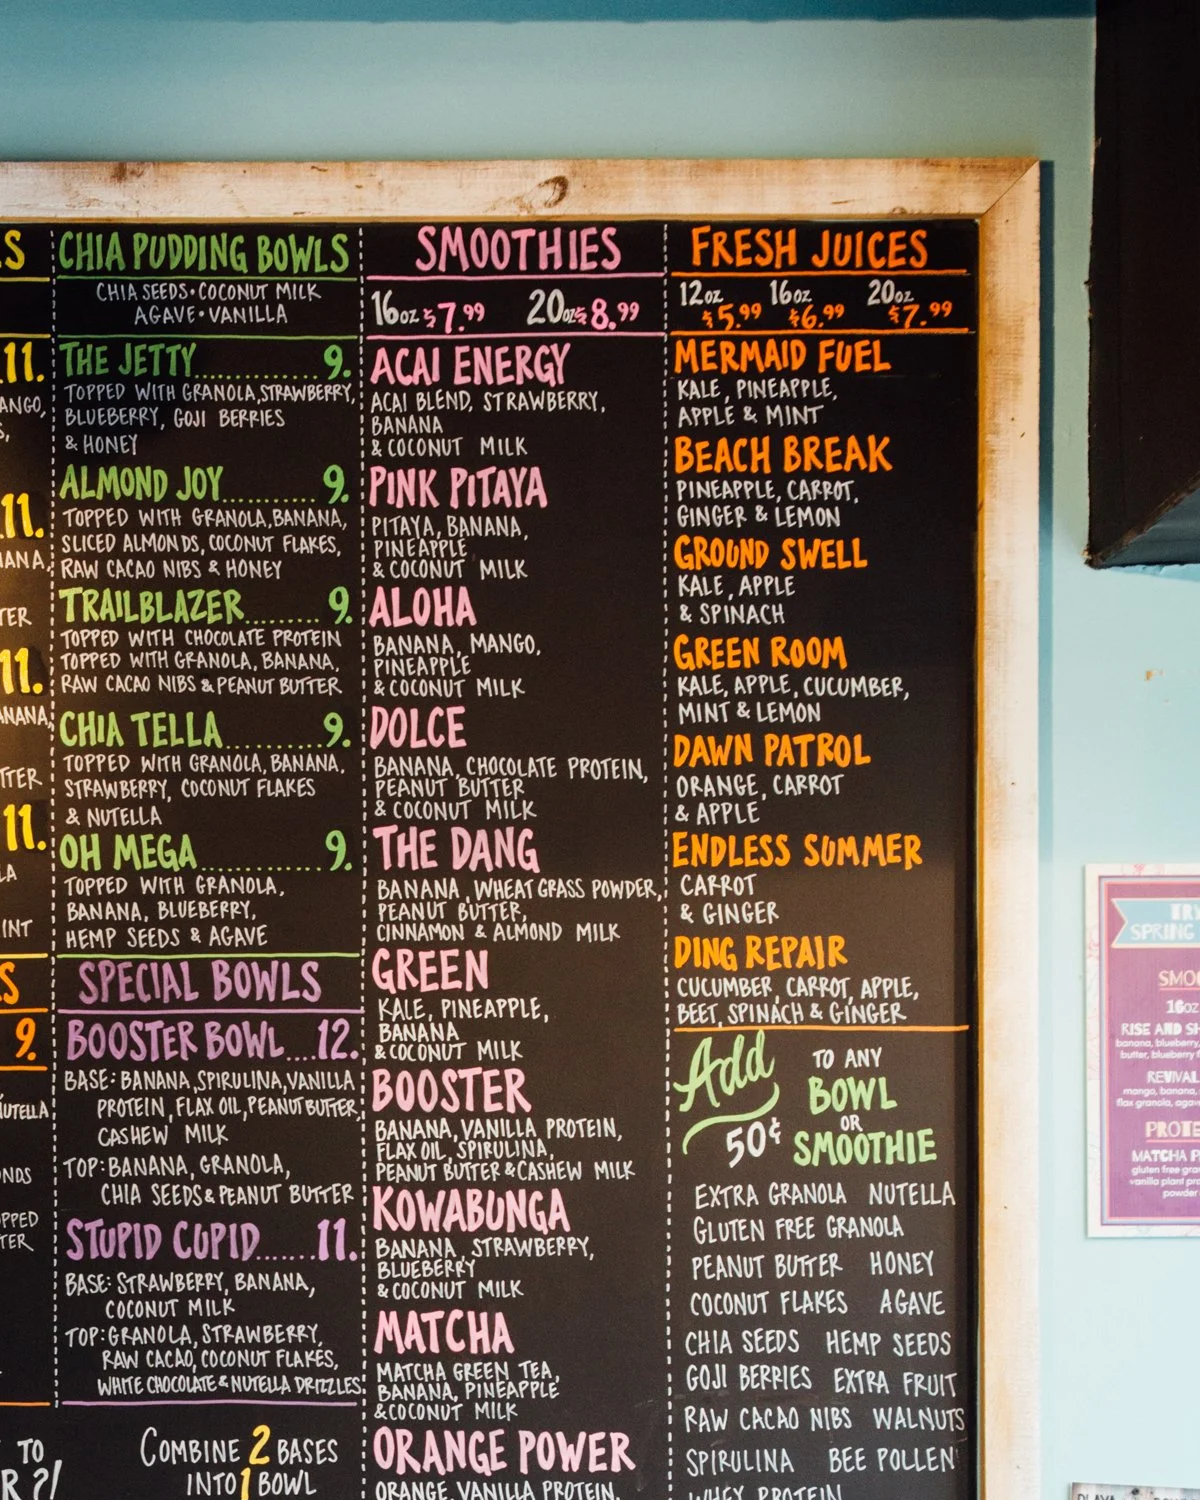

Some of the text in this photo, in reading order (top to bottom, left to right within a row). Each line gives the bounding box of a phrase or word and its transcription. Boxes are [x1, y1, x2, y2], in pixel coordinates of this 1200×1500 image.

[58, 233, 350, 275] CHIA PUDDING BOWLS
[415, 226, 622, 273] SMOOTHIES
[691, 226, 928, 270] FRESH JUICES
[58, 341, 110, 378] THE
[118, 342, 197, 378] JETTY
[369, 342, 571, 388] ACAI ENERGY
[674, 338, 892, 375] MERMAID FUEL
[59, 710, 125, 747] CHIA
[130, 710, 224, 749] TELLA
[672, 831, 923, 871] ENDLESS SUMMER
[65, 924, 268, 950] HEMP SEEDS & AGAVE
[376, 921, 621, 944] CINNAMON & ALMOND MILK
[1131, 923, 1195, 941] SPRING
[78, 959, 322, 1005] SPECIAL BOWLS
[1121, 1023, 1151, 1036] RISE
[1155, 1023, 1183, 1036] AND
[673, 1030, 776, 1112] Add
[812, 1046, 883, 1070] TO ANY
[1147, 1071, 1200, 1084] REVIVAL
[807, 1075, 898, 1116] BOWL
[726, 1119, 782, 1169] 50¢
[793, 1127, 938, 1167] SMOOTHIE
[1131, 1149, 1188, 1162] MATCHA
[372, 1185, 571, 1236] KOWABUNGA
[695, 1180, 956, 1210] EXTRA GRANOLA NUTELLA
[65, 1217, 162, 1261] STUPID
[172, 1220, 261, 1262] CUPID
[684, 1405, 964, 1433] RAW CACAO NIBS WALNUTS
[16, 1437, 45, 1465] TO
[248, 1424, 271, 1465] 2
[277, 1438, 338, 1466] BASES
